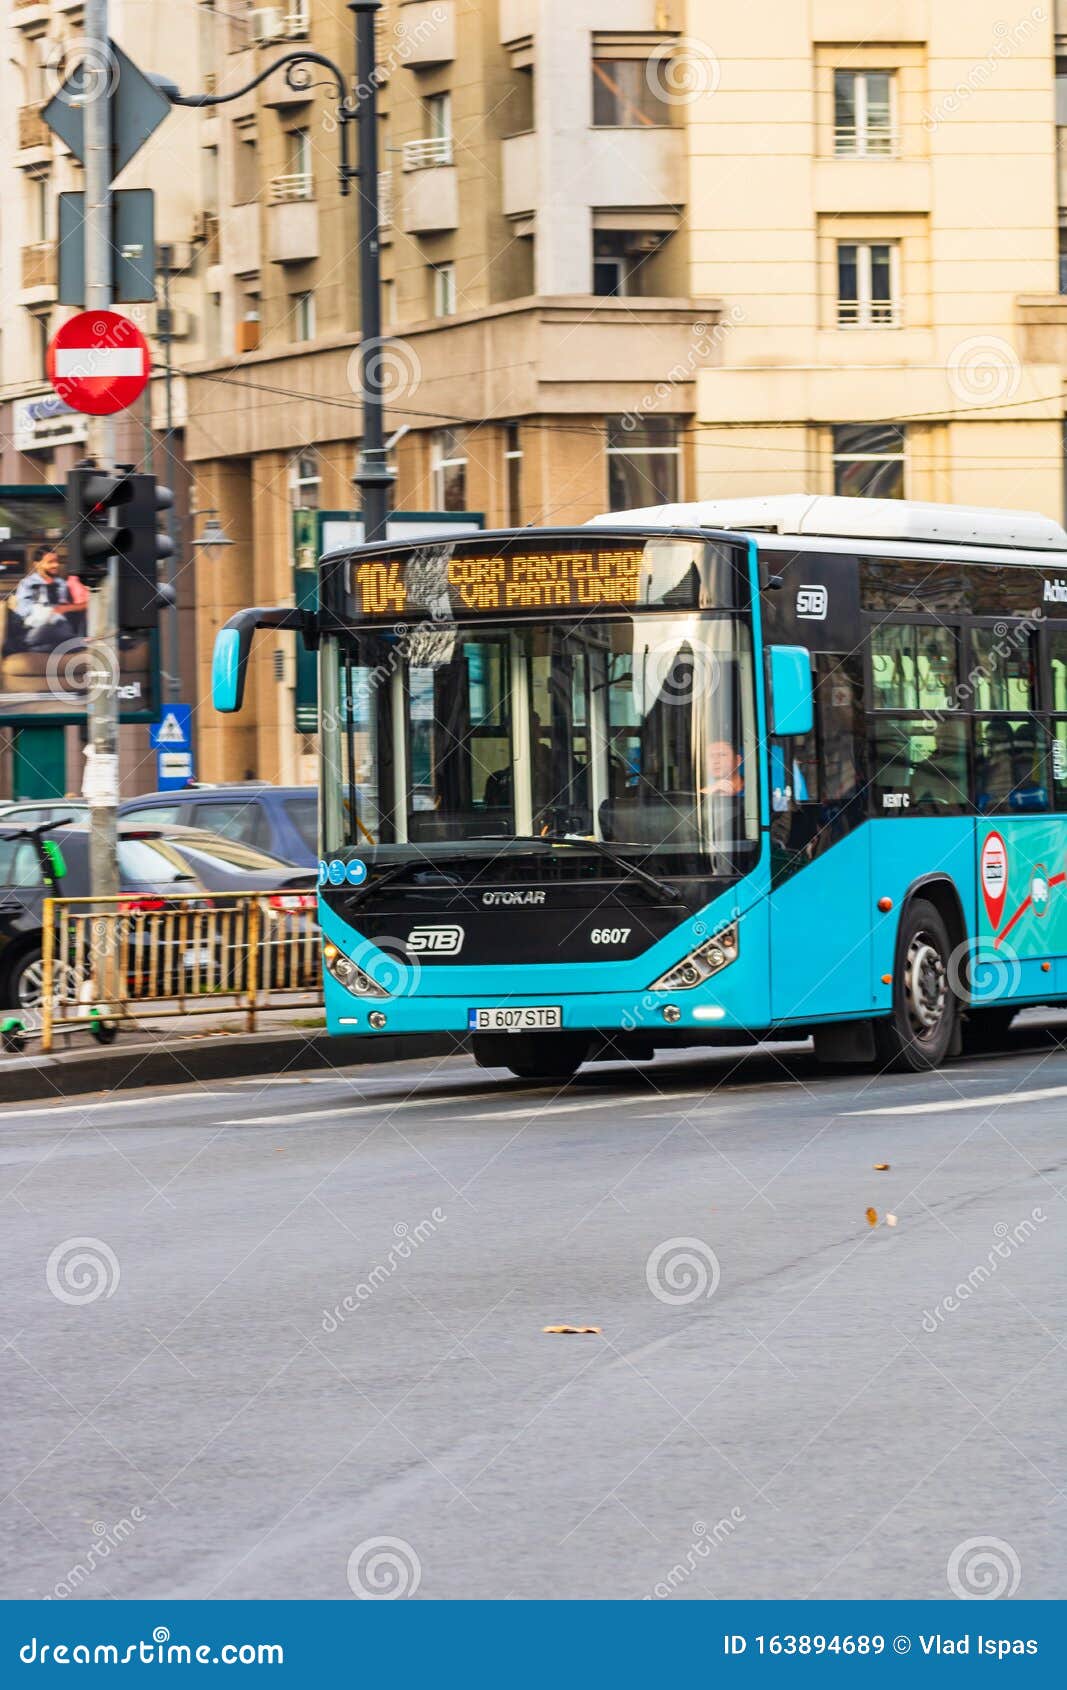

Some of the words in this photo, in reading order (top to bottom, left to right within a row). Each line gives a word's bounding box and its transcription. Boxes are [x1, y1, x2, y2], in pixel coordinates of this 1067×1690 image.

[449, 558, 505, 583] CORA
[356, 563, 406, 613] 104
[461, 584, 499, 608] VIA
[505, 581, 571, 606] PIATA
[482, 891, 546, 905] OTOKAR
[406, 927, 462, 952] STB
[590, 928, 631, 944] 6607
[479, 1011, 490, 1028] B
[495, 1010, 522, 1027] 607
[525, 1008, 557, 1027] STB
